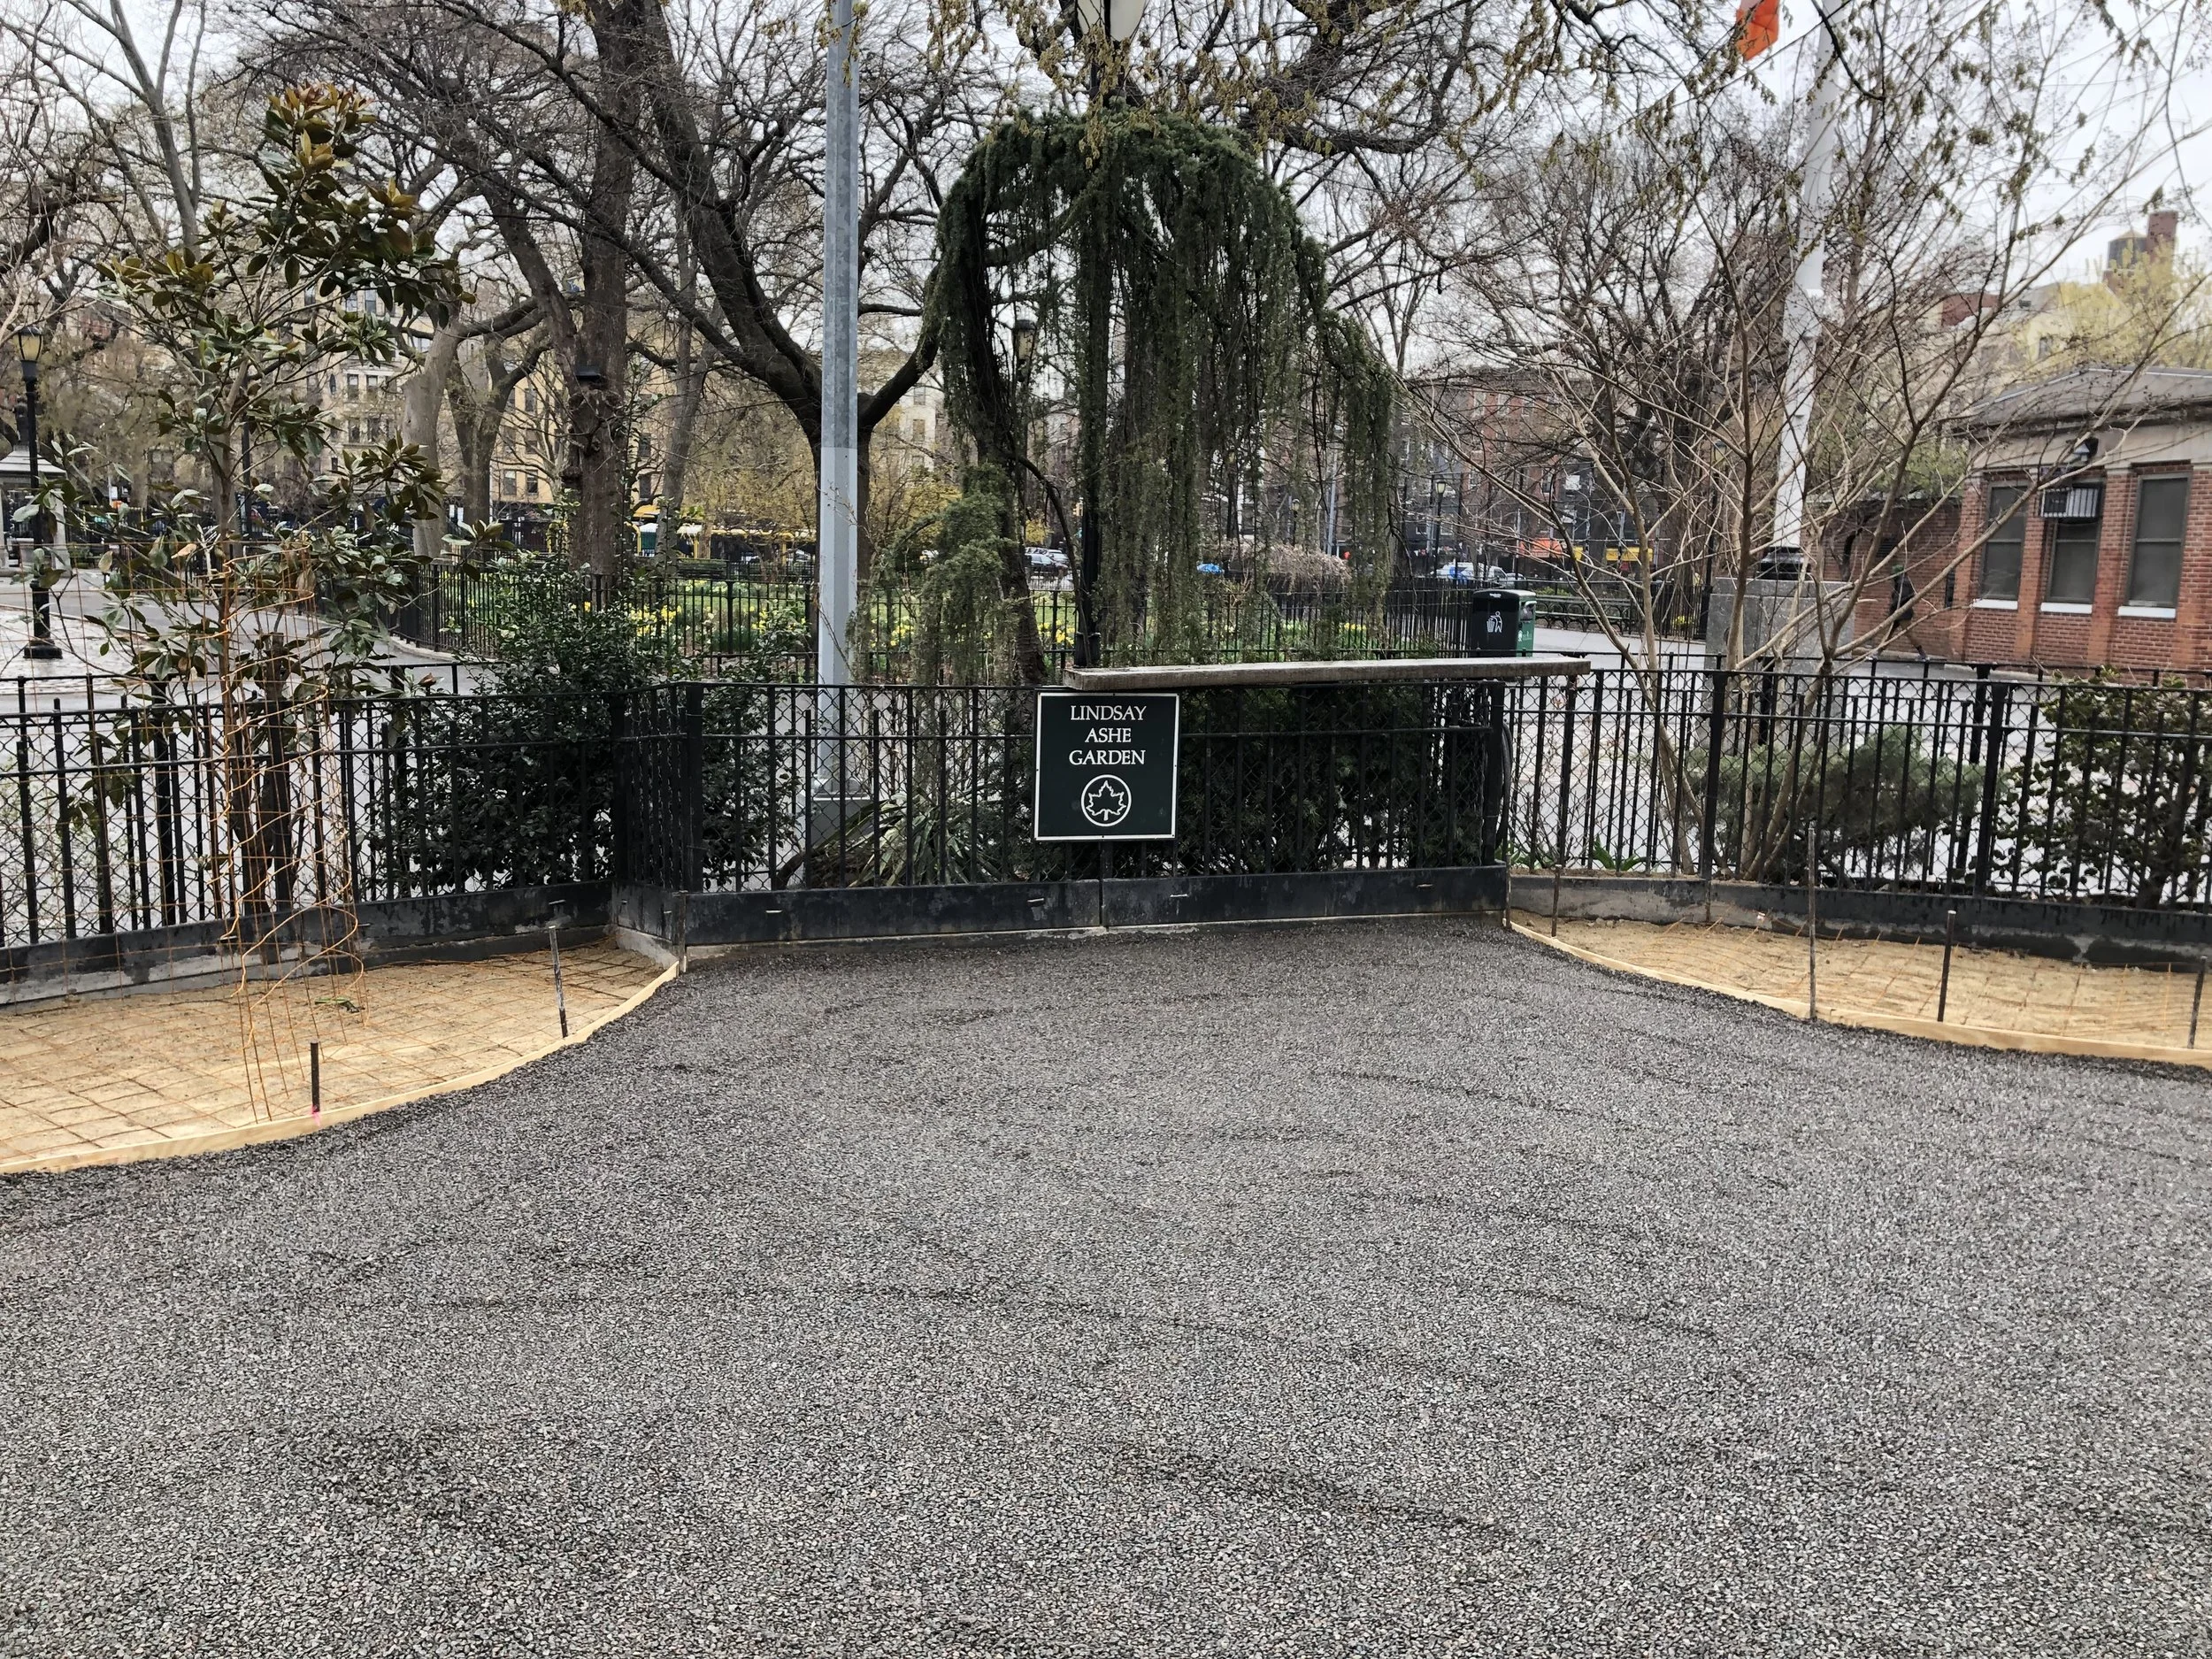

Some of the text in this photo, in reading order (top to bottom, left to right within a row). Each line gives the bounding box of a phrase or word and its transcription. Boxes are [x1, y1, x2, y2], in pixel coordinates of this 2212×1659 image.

[1070, 705, 1147, 721] LINDSAY
[1084, 727, 1132, 743] ASHE
[1068, 749, 1147, 766] GARDEN
